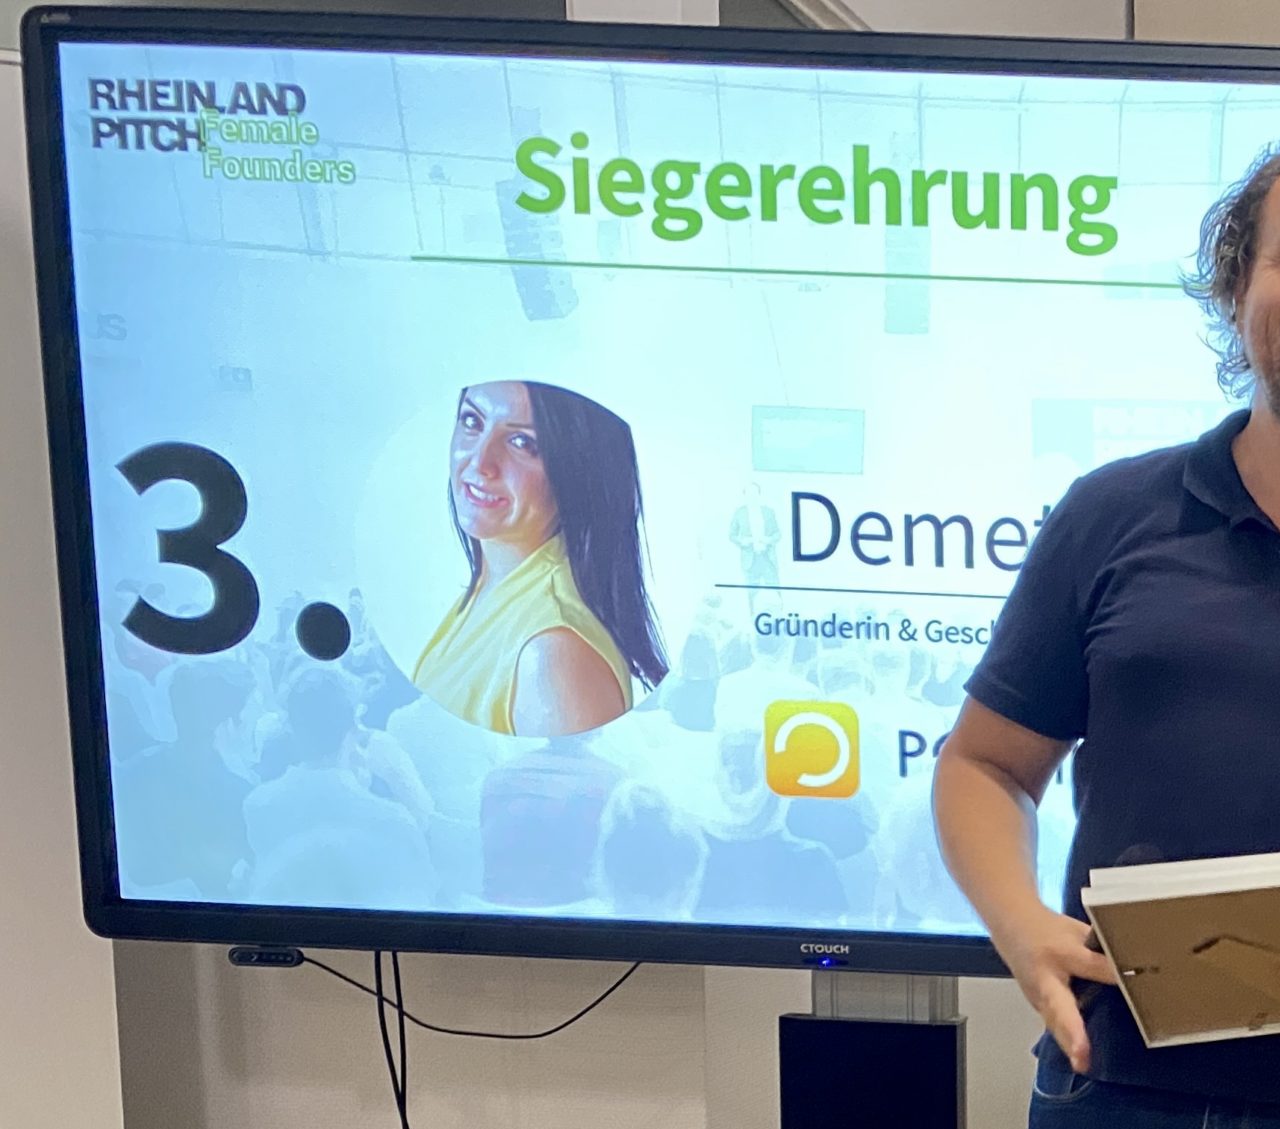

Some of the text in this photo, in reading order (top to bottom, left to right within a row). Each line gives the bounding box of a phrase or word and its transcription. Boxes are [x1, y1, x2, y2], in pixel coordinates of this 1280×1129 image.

[88, 77, 306, 116] RHEINLAND
[90, 116, 206, 152] PITCH
[200, 107, 320, 145] Female
[203, 147, 356, 183] Founders
[514, 131, 1118, 257] Siegerehrung
[114, 440, 352, 661] 3.
[754, 612, 996, 645] Gründerin & Gesc
[800, 943, 849, 954] CTOUCH
